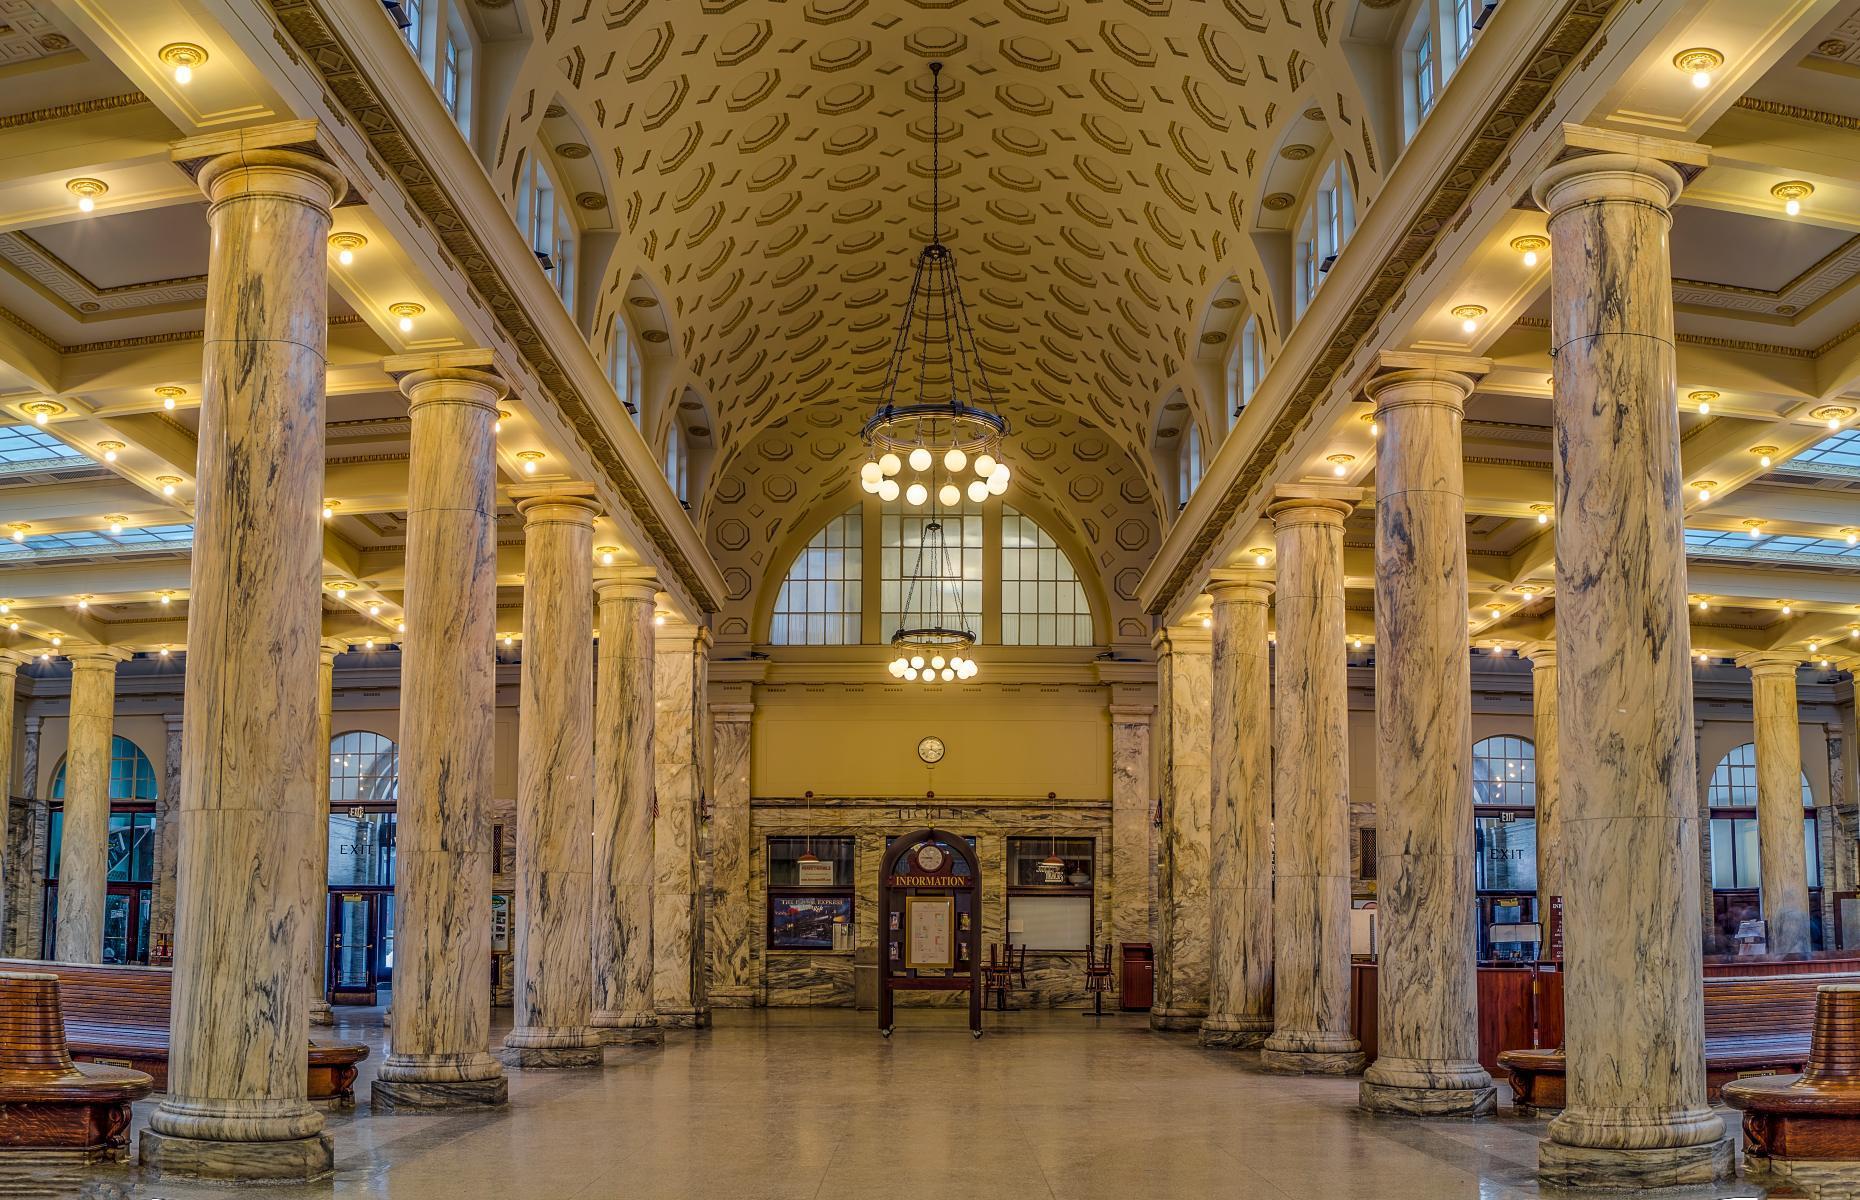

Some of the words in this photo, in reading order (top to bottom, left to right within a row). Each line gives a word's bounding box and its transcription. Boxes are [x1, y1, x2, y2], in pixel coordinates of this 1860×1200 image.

[1502, 812, 1514, 821] EXIT
[340, 844, 373, 854] EXIT
[1490, 849, 1524, 859] EXIT
[896, 876, 965, 886] INFORMATION
